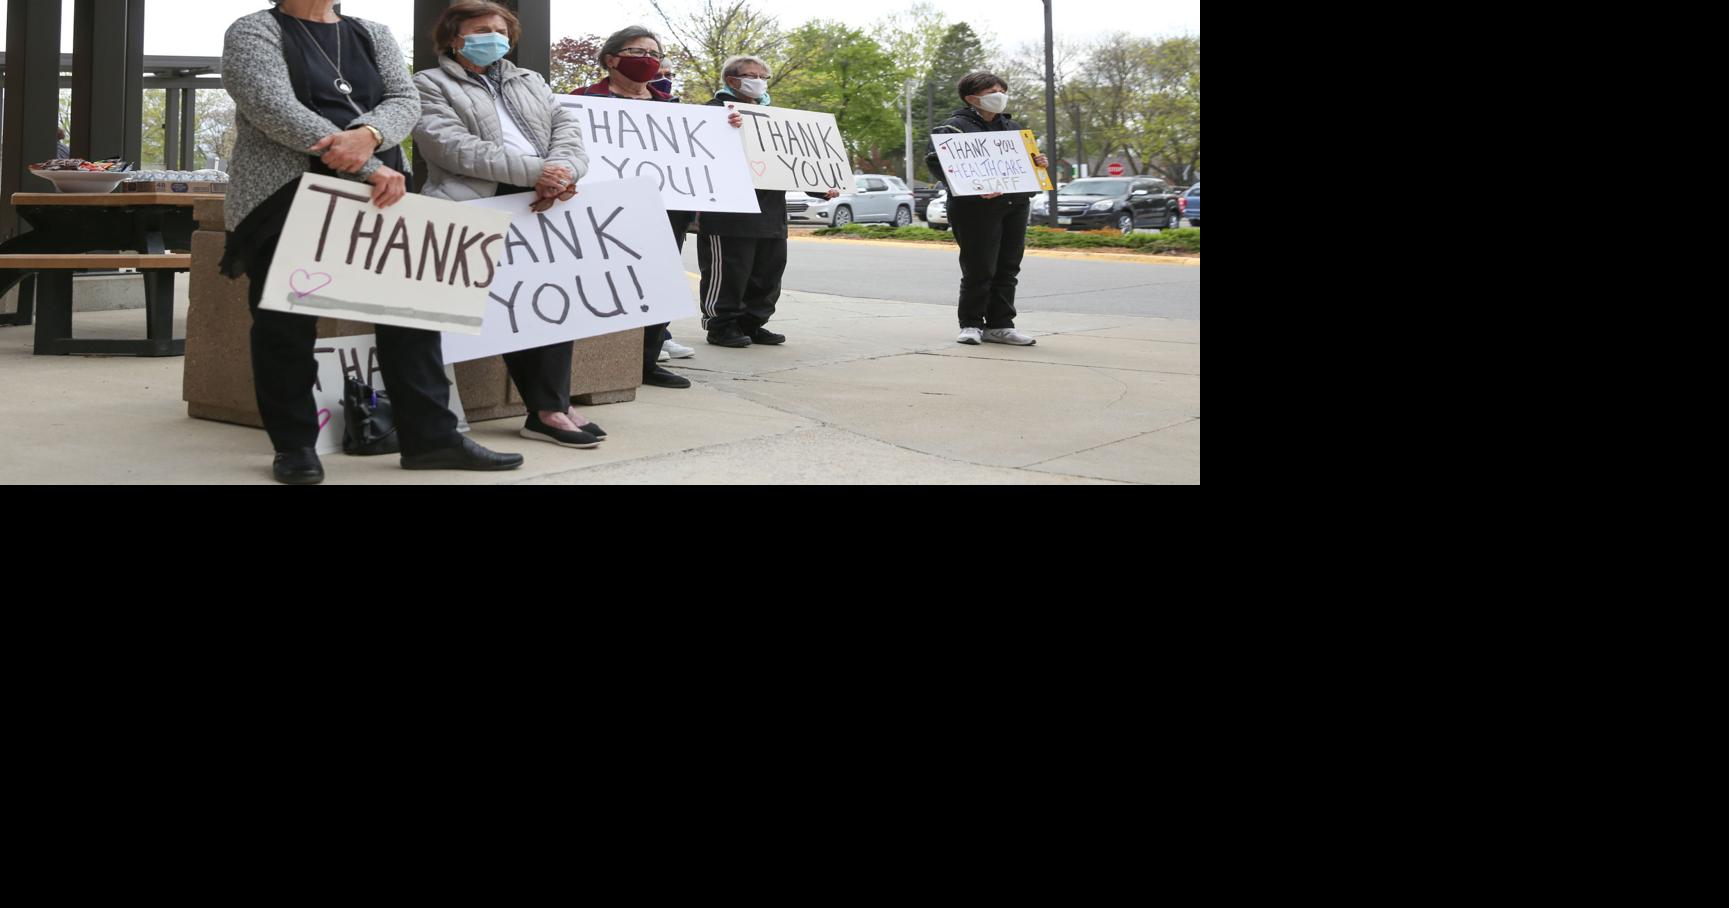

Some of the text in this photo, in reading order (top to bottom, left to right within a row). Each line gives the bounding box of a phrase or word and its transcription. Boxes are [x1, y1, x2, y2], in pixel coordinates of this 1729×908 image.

[738, 109, 844, 163] THANK
[939, 137, 990, 160] THANK
[601, 155, 717, 202] YOU!
[776, 154, 847, 191] YOU!
[954, 158, 1027, 178] HEALTHCARE
[971, 177, 1020, 191] STAFF
[308, 184, 504, 288] THANKS
[497, 206, 642, 267] ANK
[489, 265, 649, 334] YOU!
